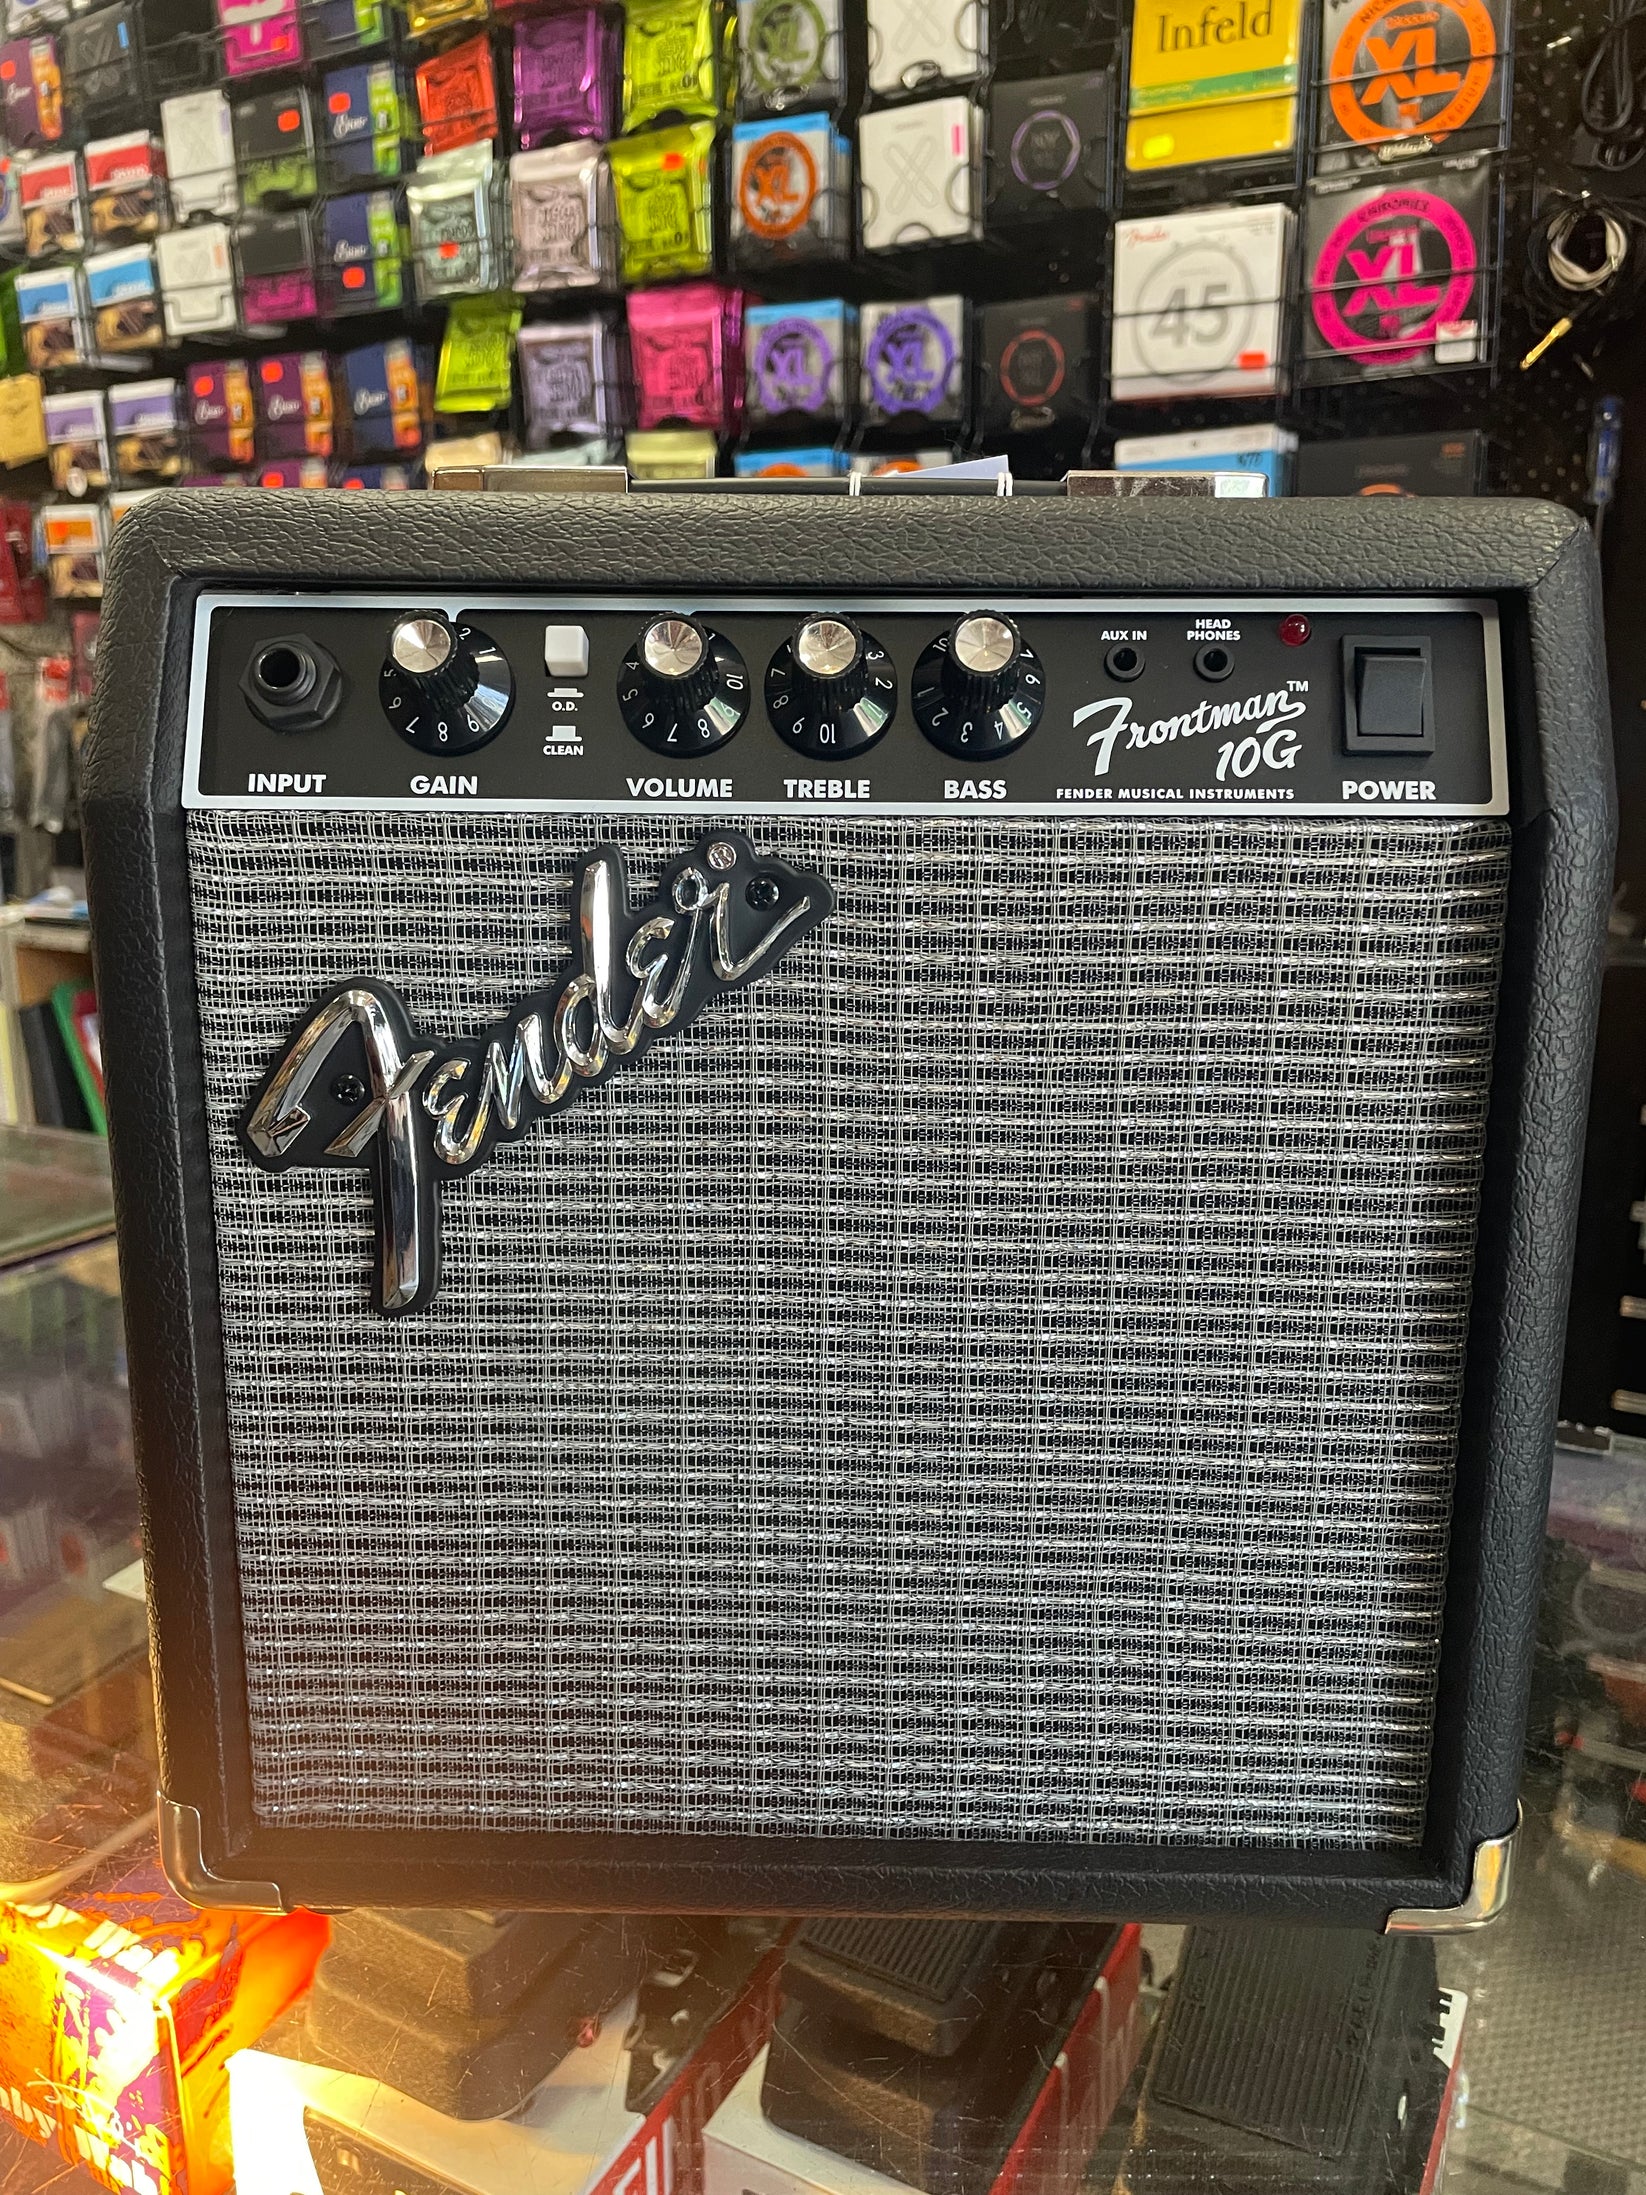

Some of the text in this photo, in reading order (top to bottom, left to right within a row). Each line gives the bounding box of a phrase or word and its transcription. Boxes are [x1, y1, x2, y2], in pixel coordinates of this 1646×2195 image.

[1157, 0, 1273, 53] Infeld
[1360, 26, 1462, 106] XL
[1340, 243, 1442, 318] XL
[1151, 283, 1230, 348] 45
[1195, 618, 1232, 630] HEAD
[457, 627, 472, 641] 2
[1100, 630, 1148, 641] AUX IN
[1186, 630, 1241, 641] PHONES
[479, 646, 497, 655] 1
[867, 650, 885, 661] 3
[625, 661, 640, 671] 4
[770, 667, 786, 678] 7
[726, 674, 744, 690] 10
[875, 676, 893, 691] 2
[622, 688, 639, 702] 5
[773, 694, 789, 710] 8
[551, 700, 578, 712] O.D.
[916, 686, 935, 698] 1
[931, 706, 950, 728] 2
[960, 721, 974, 744] 3
[993, 720, 1004, 741] 4
[1016, 701, 1033, 721] 5
[405, 716, 420, 734] 7
[437, 721, 448, 742] 8
[667, 723, 678, 742] 7
[697, 718, 711, 739] 8
[819, 723, 837, 744] 10
[542, 744, 584, 756] CLEAN
[1215, 729, 1303, 782] 10G
[247, 773, 327, 794] INPUT
[409, 775, 478, 796] GAIN
[626, 777, 734, 799] VOLUME
[783, 779, 871, 799] TREBLE
[944, 780, 1008, 800] BASS
[1341, 780, 1437, 801] POWER
[1056, 788, 1295, 800] FENDER MUSICAL INSTRUMENTS
